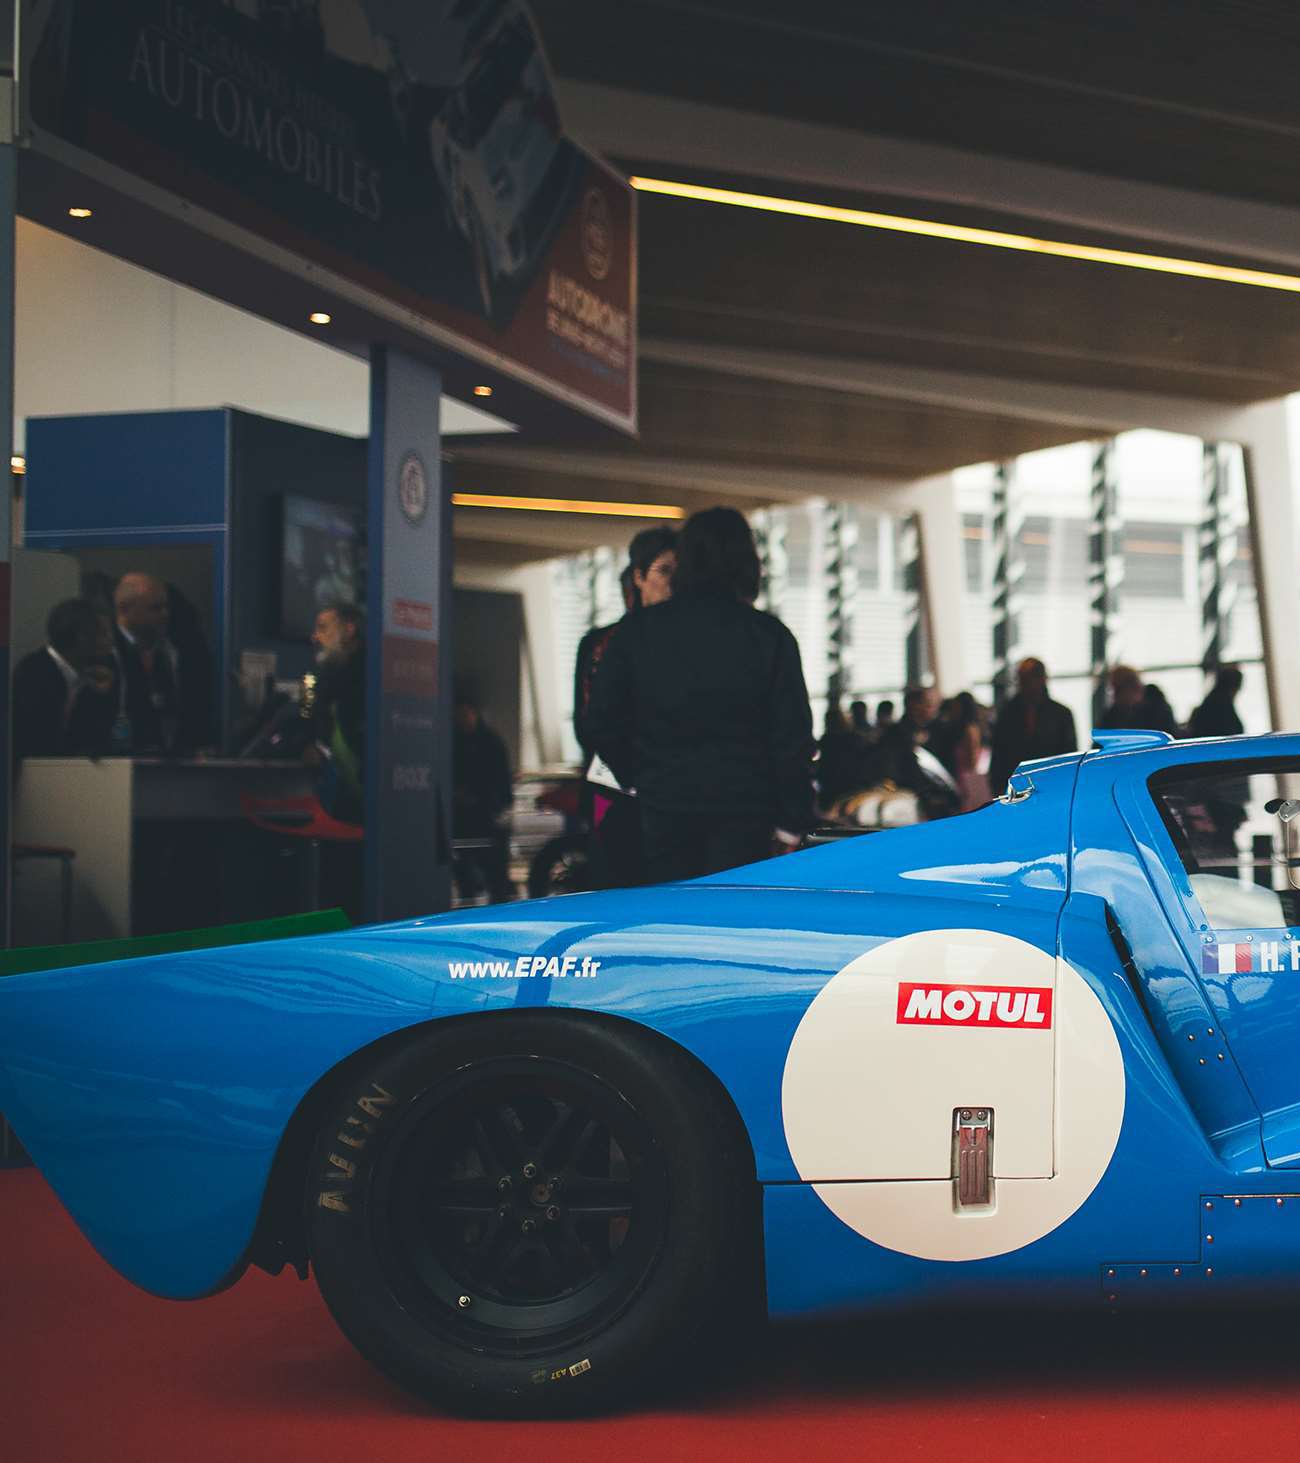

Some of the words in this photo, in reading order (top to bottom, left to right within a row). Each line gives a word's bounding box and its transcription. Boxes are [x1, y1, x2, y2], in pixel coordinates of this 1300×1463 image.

[129, 27, 384, 223] AUTOMOBILES
[448, 956, 602, 979] www.EPAF.fr
[1260, 942, 1285, 972] H.
[903, 989, 1046, 1023] MOTUL
[318, 1082, 400, 1214] AVON
